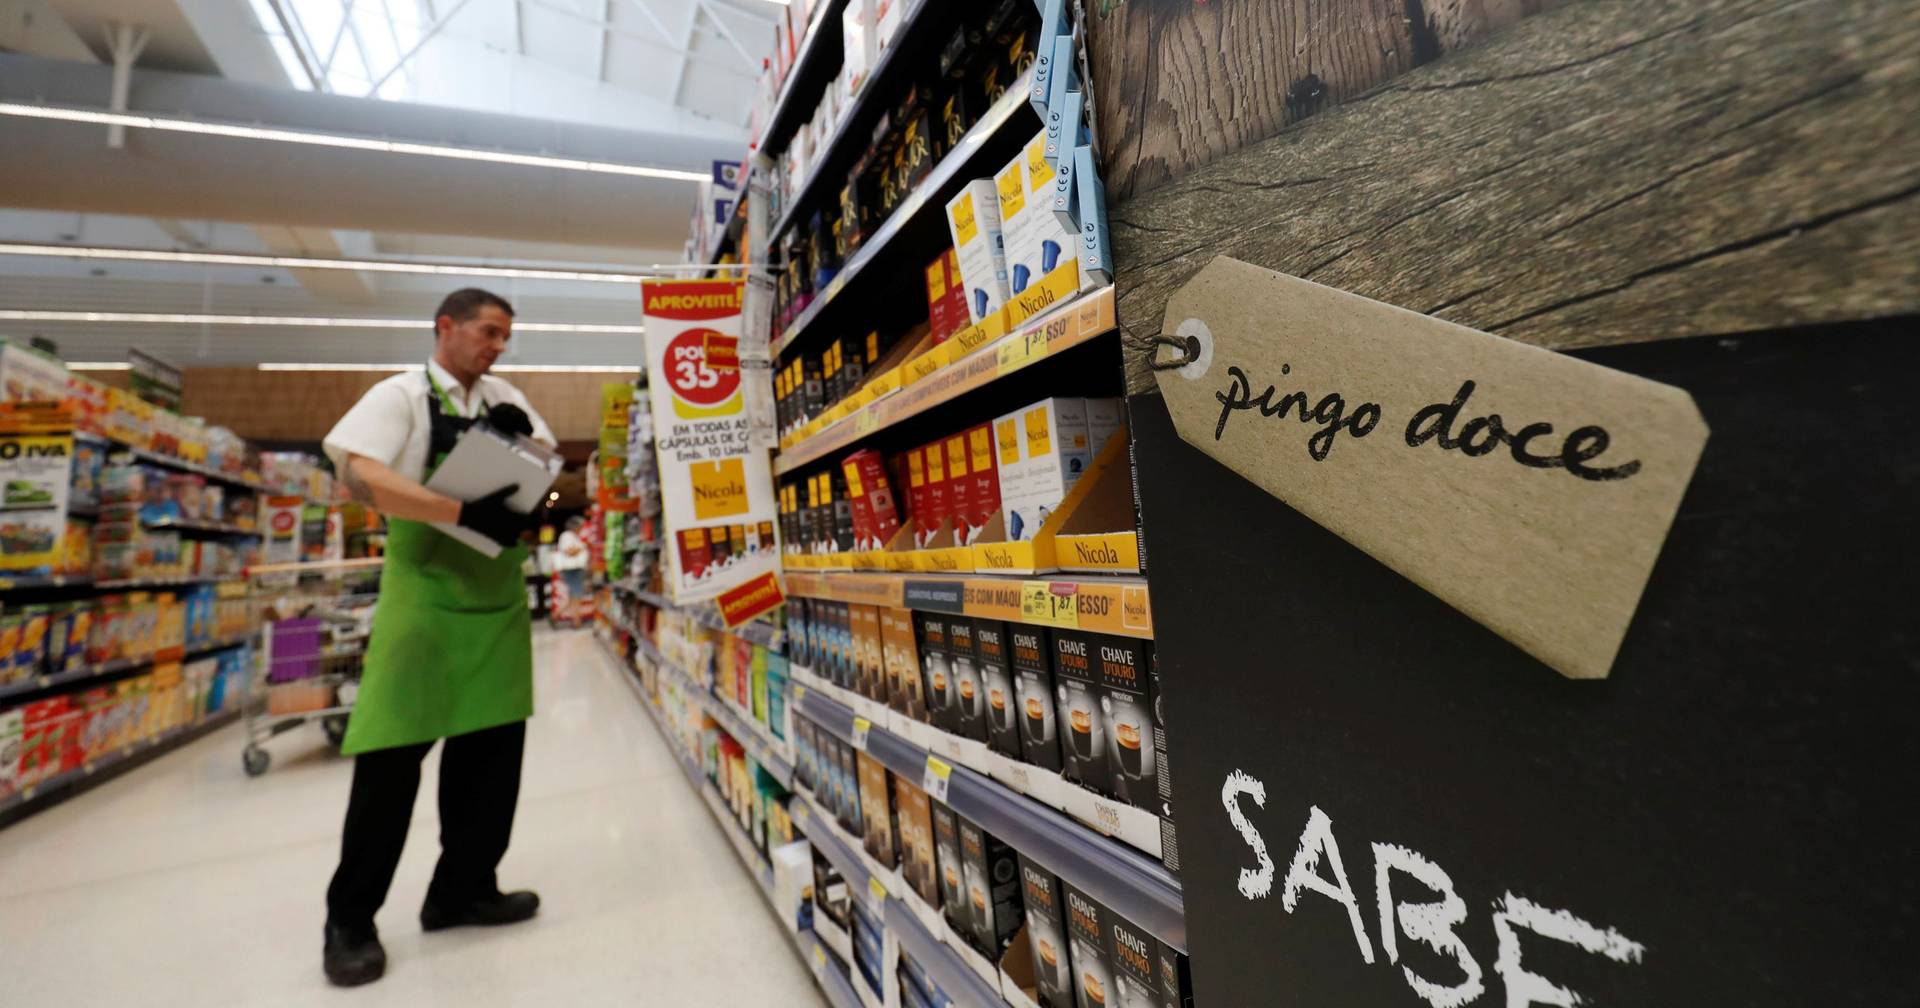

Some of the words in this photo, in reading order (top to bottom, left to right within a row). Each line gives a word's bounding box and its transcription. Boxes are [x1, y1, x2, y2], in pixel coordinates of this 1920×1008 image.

[1028, 158, 1047, 175] Nico
[1000, 183, 1023, 203] Nicola
[954, 213, 975, 231] Nicola
[648, 285, 744, 310] APROVEITE!
[1020, 286, 1055, 320] Nicola
[957, 325, 987, 353] Nicola
[673, 425, 690, 436] EM
[694, 420, 731, 434] TODAS
[735, 420, 748, 430] AS
[1215, 363, 1382, 462] pingo
[1404, 379, 1643, 482] doce
[659, 435, 718, 451] CÁPSULAS
[721, 433, 734, 443] DE
[1027, 426, 1049, 442] Nicola
[26, 444, 66, 457] IVA
[677, 450, 703, 462] Emb.
[709, 447, 721, 458] 10
[694, 481, 744, 499] Nicola
[984, 549, 1014, 569] Nicola
[1075, 541, 1120, 565] Nicola
[930, 555, 958, 570] Nicola
[976, 588, 994, 606] COM
[1124, 602, 1147, 616] Nicola
[951, 625, 971, 638] CHAVE
[979, 630, 1000, 645] CHAVE
[1014, 634, 1038, 649] CHAVE
[1058, 639, 1087, 656] CHAVE
[1060, 653, 1088, 670] D'OURO
[1101, 646, 1134, 666] CHAVE
[1103, 662, 1136, 680] D'OURO
[1024, 867, 1050, 894] CHAVE
[1069, 892, 1098, 924] CHAVE
[1113, 924, 1149, 960] CHAVE
[1116, 941, 1151, 975] D'OURO
